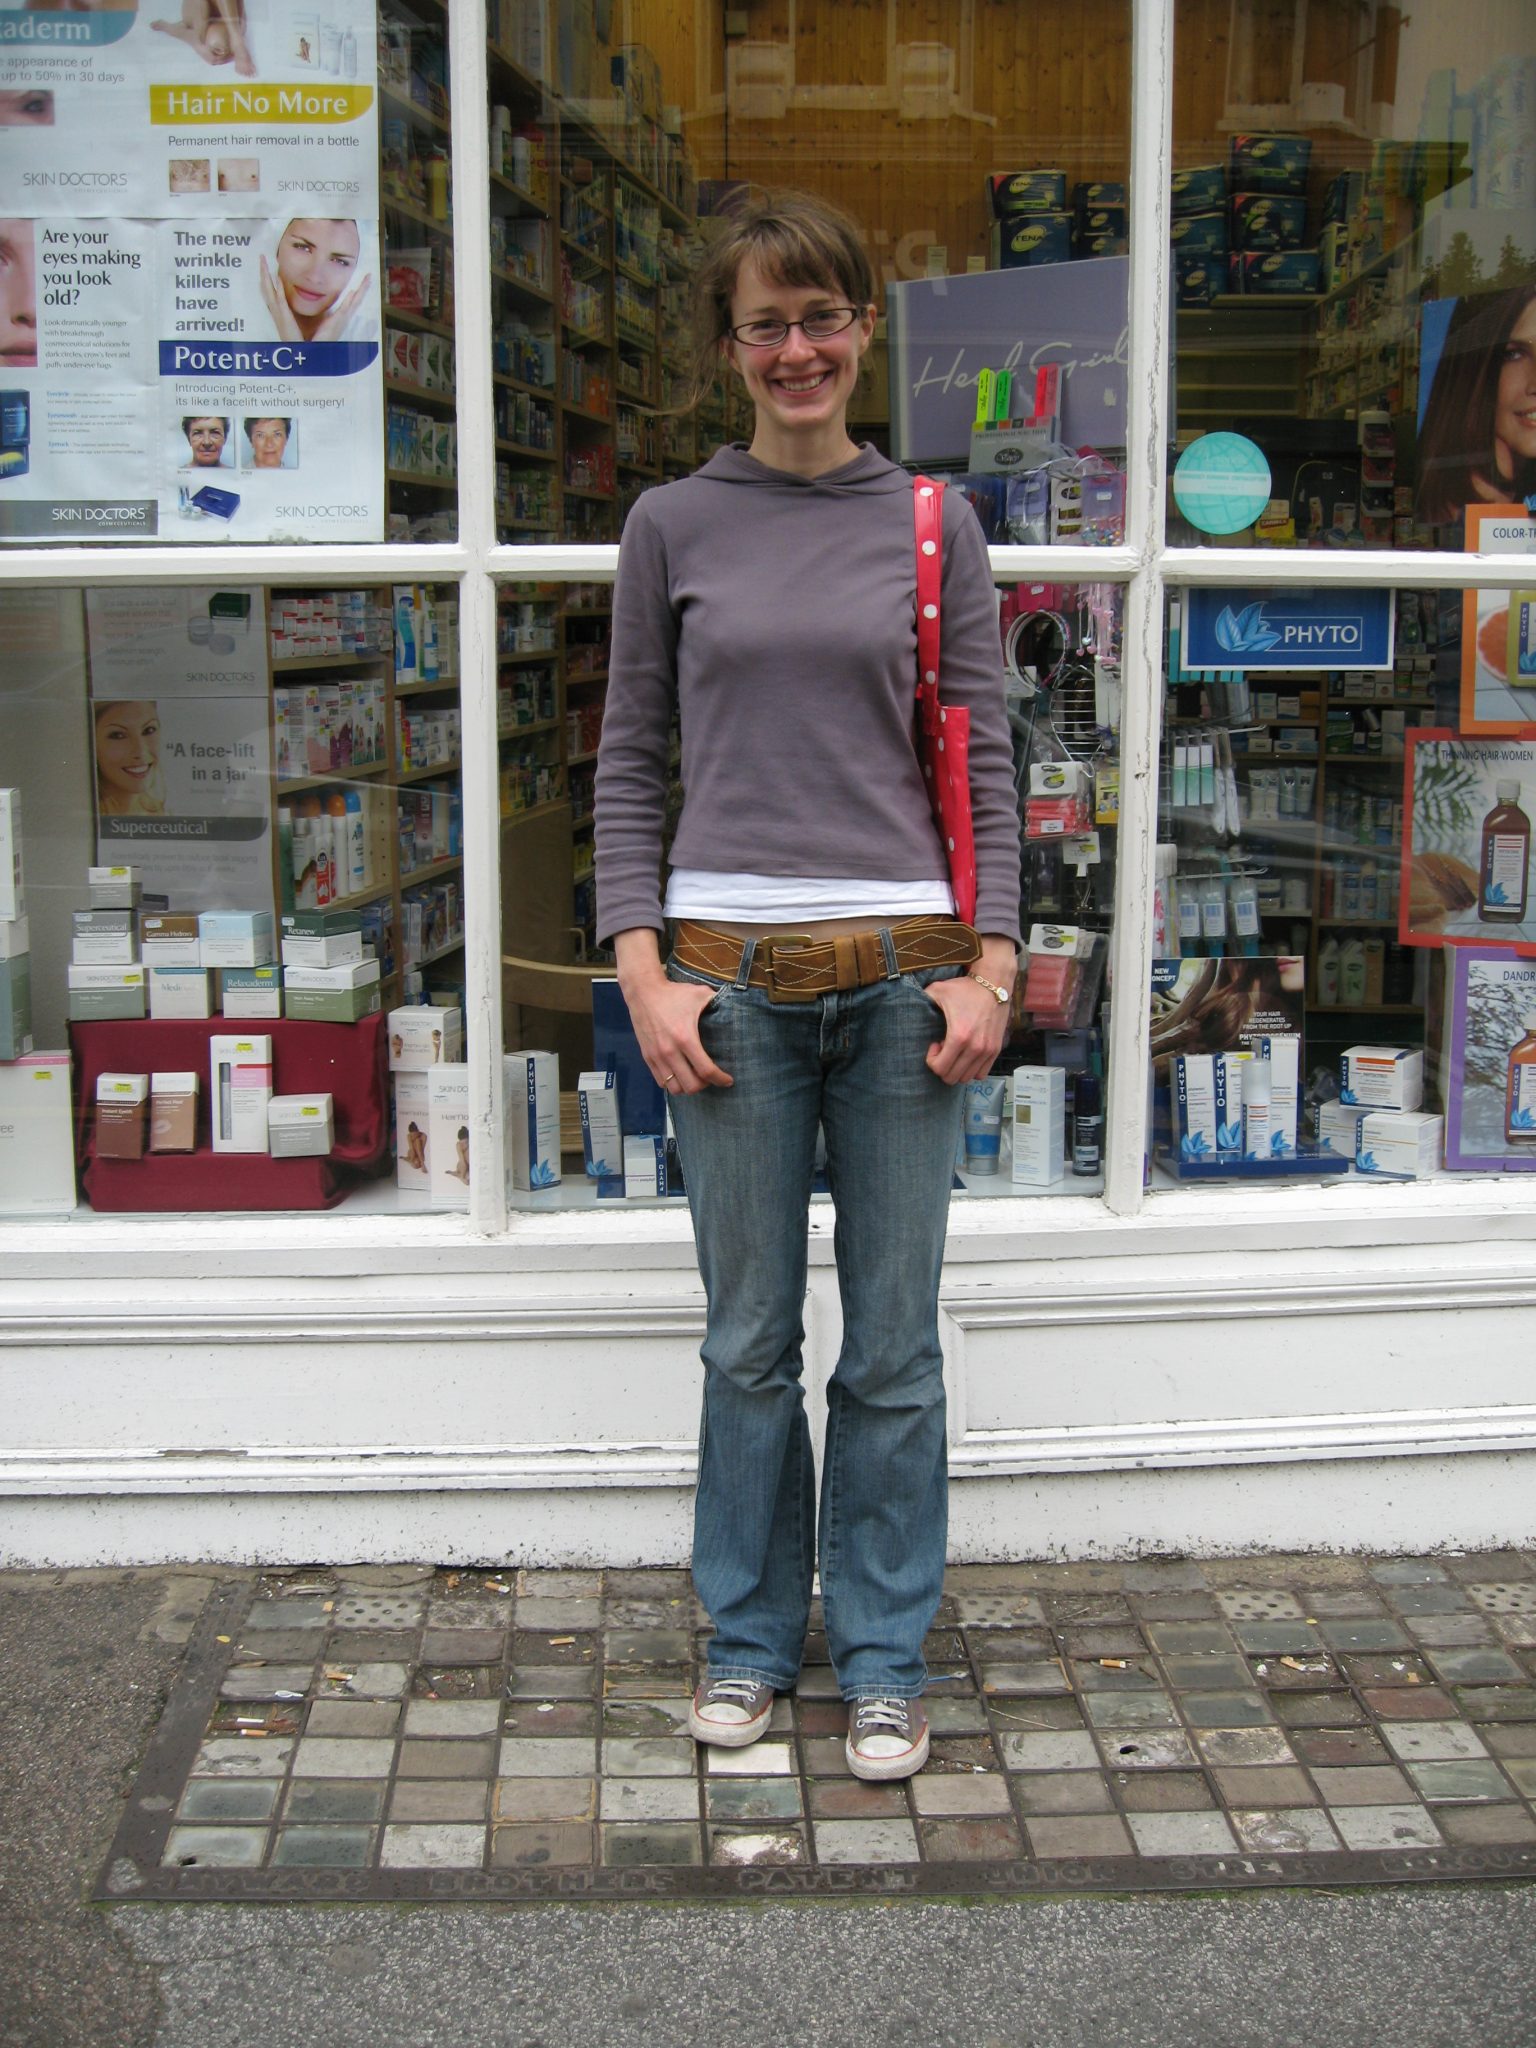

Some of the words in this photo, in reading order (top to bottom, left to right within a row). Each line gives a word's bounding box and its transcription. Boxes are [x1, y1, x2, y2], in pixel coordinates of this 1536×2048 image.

[7, 57, 78, 70] appearance
[81, 57, 93, 68] of
[1, 71, 17, 84] up
[20, 71, 32, 81] to
[35, 71, 62, 82] 50%
[65, 71, 76, 81] in
[79, 71, 94, 82] 30
[98, 71, 125, 84] days
[168, 91, 224, 115] Hair
[233, 90, 270, 114] No
[279, 91, 348, 115] More
[168, 135, 228, 147] Permanent
[231, 135, 252, 146] hair
[255, 135, 300, 147] removal
[303, 136, 314, 146] in
[317, 138, 324, 146] a
[327, 136, 360, 147] bottle
[24, 172, 56, 187] SKIN
[59, 172, 128, 186] DOCTORS
[277, 181, 304, 193] SKIN
[306, 181, 360, 193] DOCTORS
[42, 229, 68, 245] Are
[72, 230, 110, 250] your
[173, 231, 208, 247] The
[212, 232, 252, 247] new
[1015, 234, 1043, 242] TENA
[42, 251, 79, 270] eyes
[82, 249, 142, 271] making
[174, 253, 243, 270] wrinkle
[42, 271, 76, 287] you
[76, 269, 112, 286] look
[175, 274, 230, 290] killers
[44, 288, 80, 307] old?
[175, 296, 219, 312] have
[102, 320, 127, 328] younger
[175, 317, 245, 333] arrived!
[175, 345, 307, 371] Potent-C+
[913, 341, 1023, 398] Hed
[176, 383, 236, 396] Introducing
[175, 397, 188, 407] its
[191, 396, 210, 407] like
[212, 399, 219, 407] a
[222, 396, 258, 407] facelift
[260, 397, 300, 408] without
[303, 397, 345, 410] surgery!
[52, 507, 82, 520] SKIN
[85, 507, 145, 520] DOCTORS
[275, 505, 304, 518] SKIN
[307, 505, 369, 518] DOCTORS
[1284, 625, 1359, 644] PHYTO
[186, 672, 208, 683] SKIN
[209, 672, 256, 683] DOCTORS
[190, 742, 255, 758] face-lift
[1441, 749, 1479, 761] THINNING
[192, 766, 207, 781] in
[211, 769, 222, 781] a
[111, 818, 209, 837] Superceutical
[75, 922, 127, 932] Superceutical
[1154, 967, 1169, 975] NEW
[227, 979, 274, 988] Relaxaderm
[439, 1085, 456, 1093] SKIN
[528, 1062, 536, 1102] PHYTO
[1178, 1063, 1187, 1101] PHYTO
[1216, 1058, 1226, 1107] PHYTO
[579, 1093, 590, 1127] PHYTO
[428, 1867, 678, 1893] BROTHERS
[736, 1867, 918, 1892] PATENT
